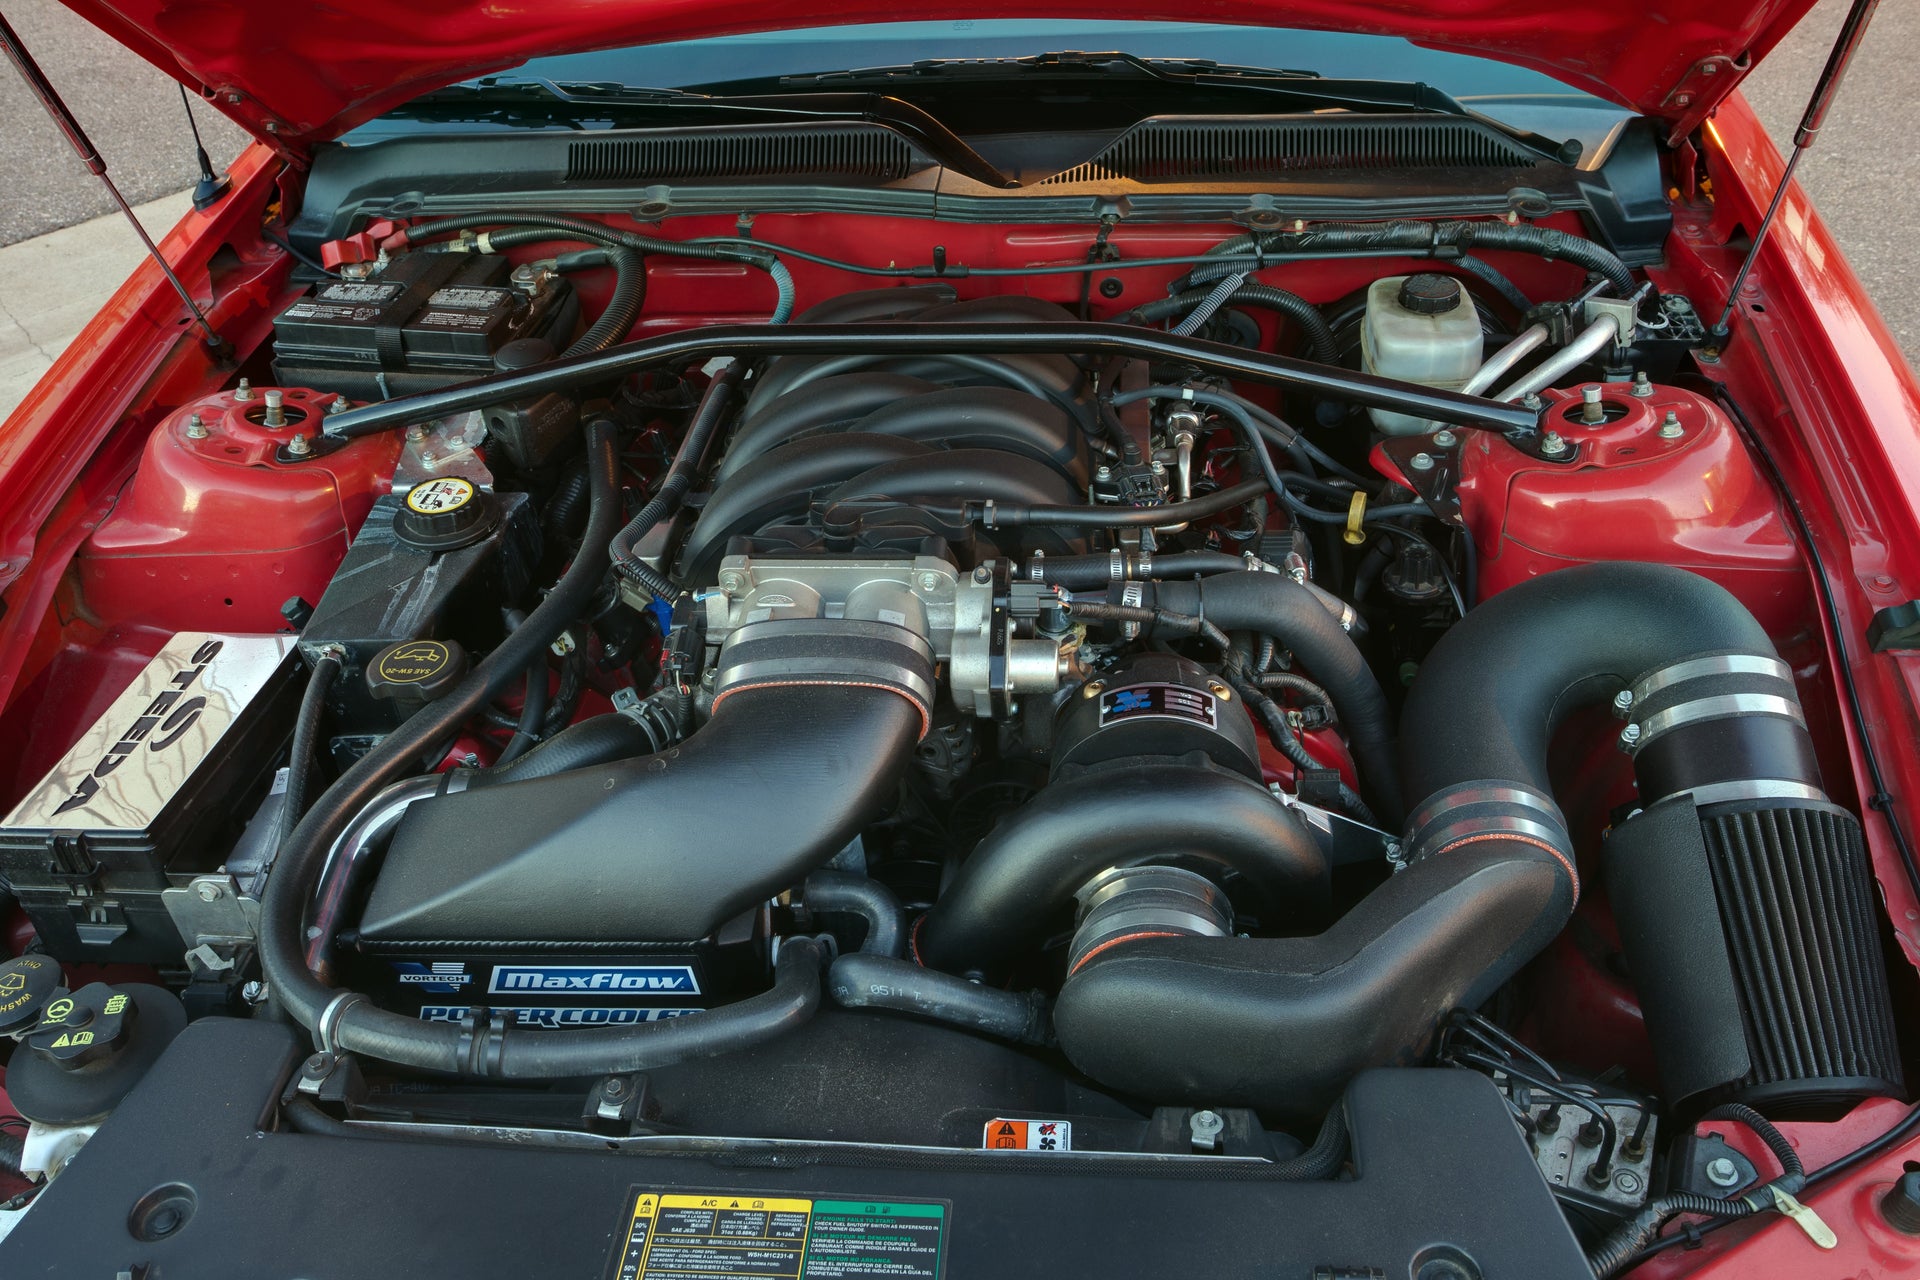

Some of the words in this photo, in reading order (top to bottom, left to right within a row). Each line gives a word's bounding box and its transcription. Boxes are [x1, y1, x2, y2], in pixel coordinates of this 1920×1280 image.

[52, 641, 223, 816] STEEDA
[16, 960, 42, 969] ONLY
[870, 984, 902, 996] 0511
[421, 1007, 558, 1028] POER
